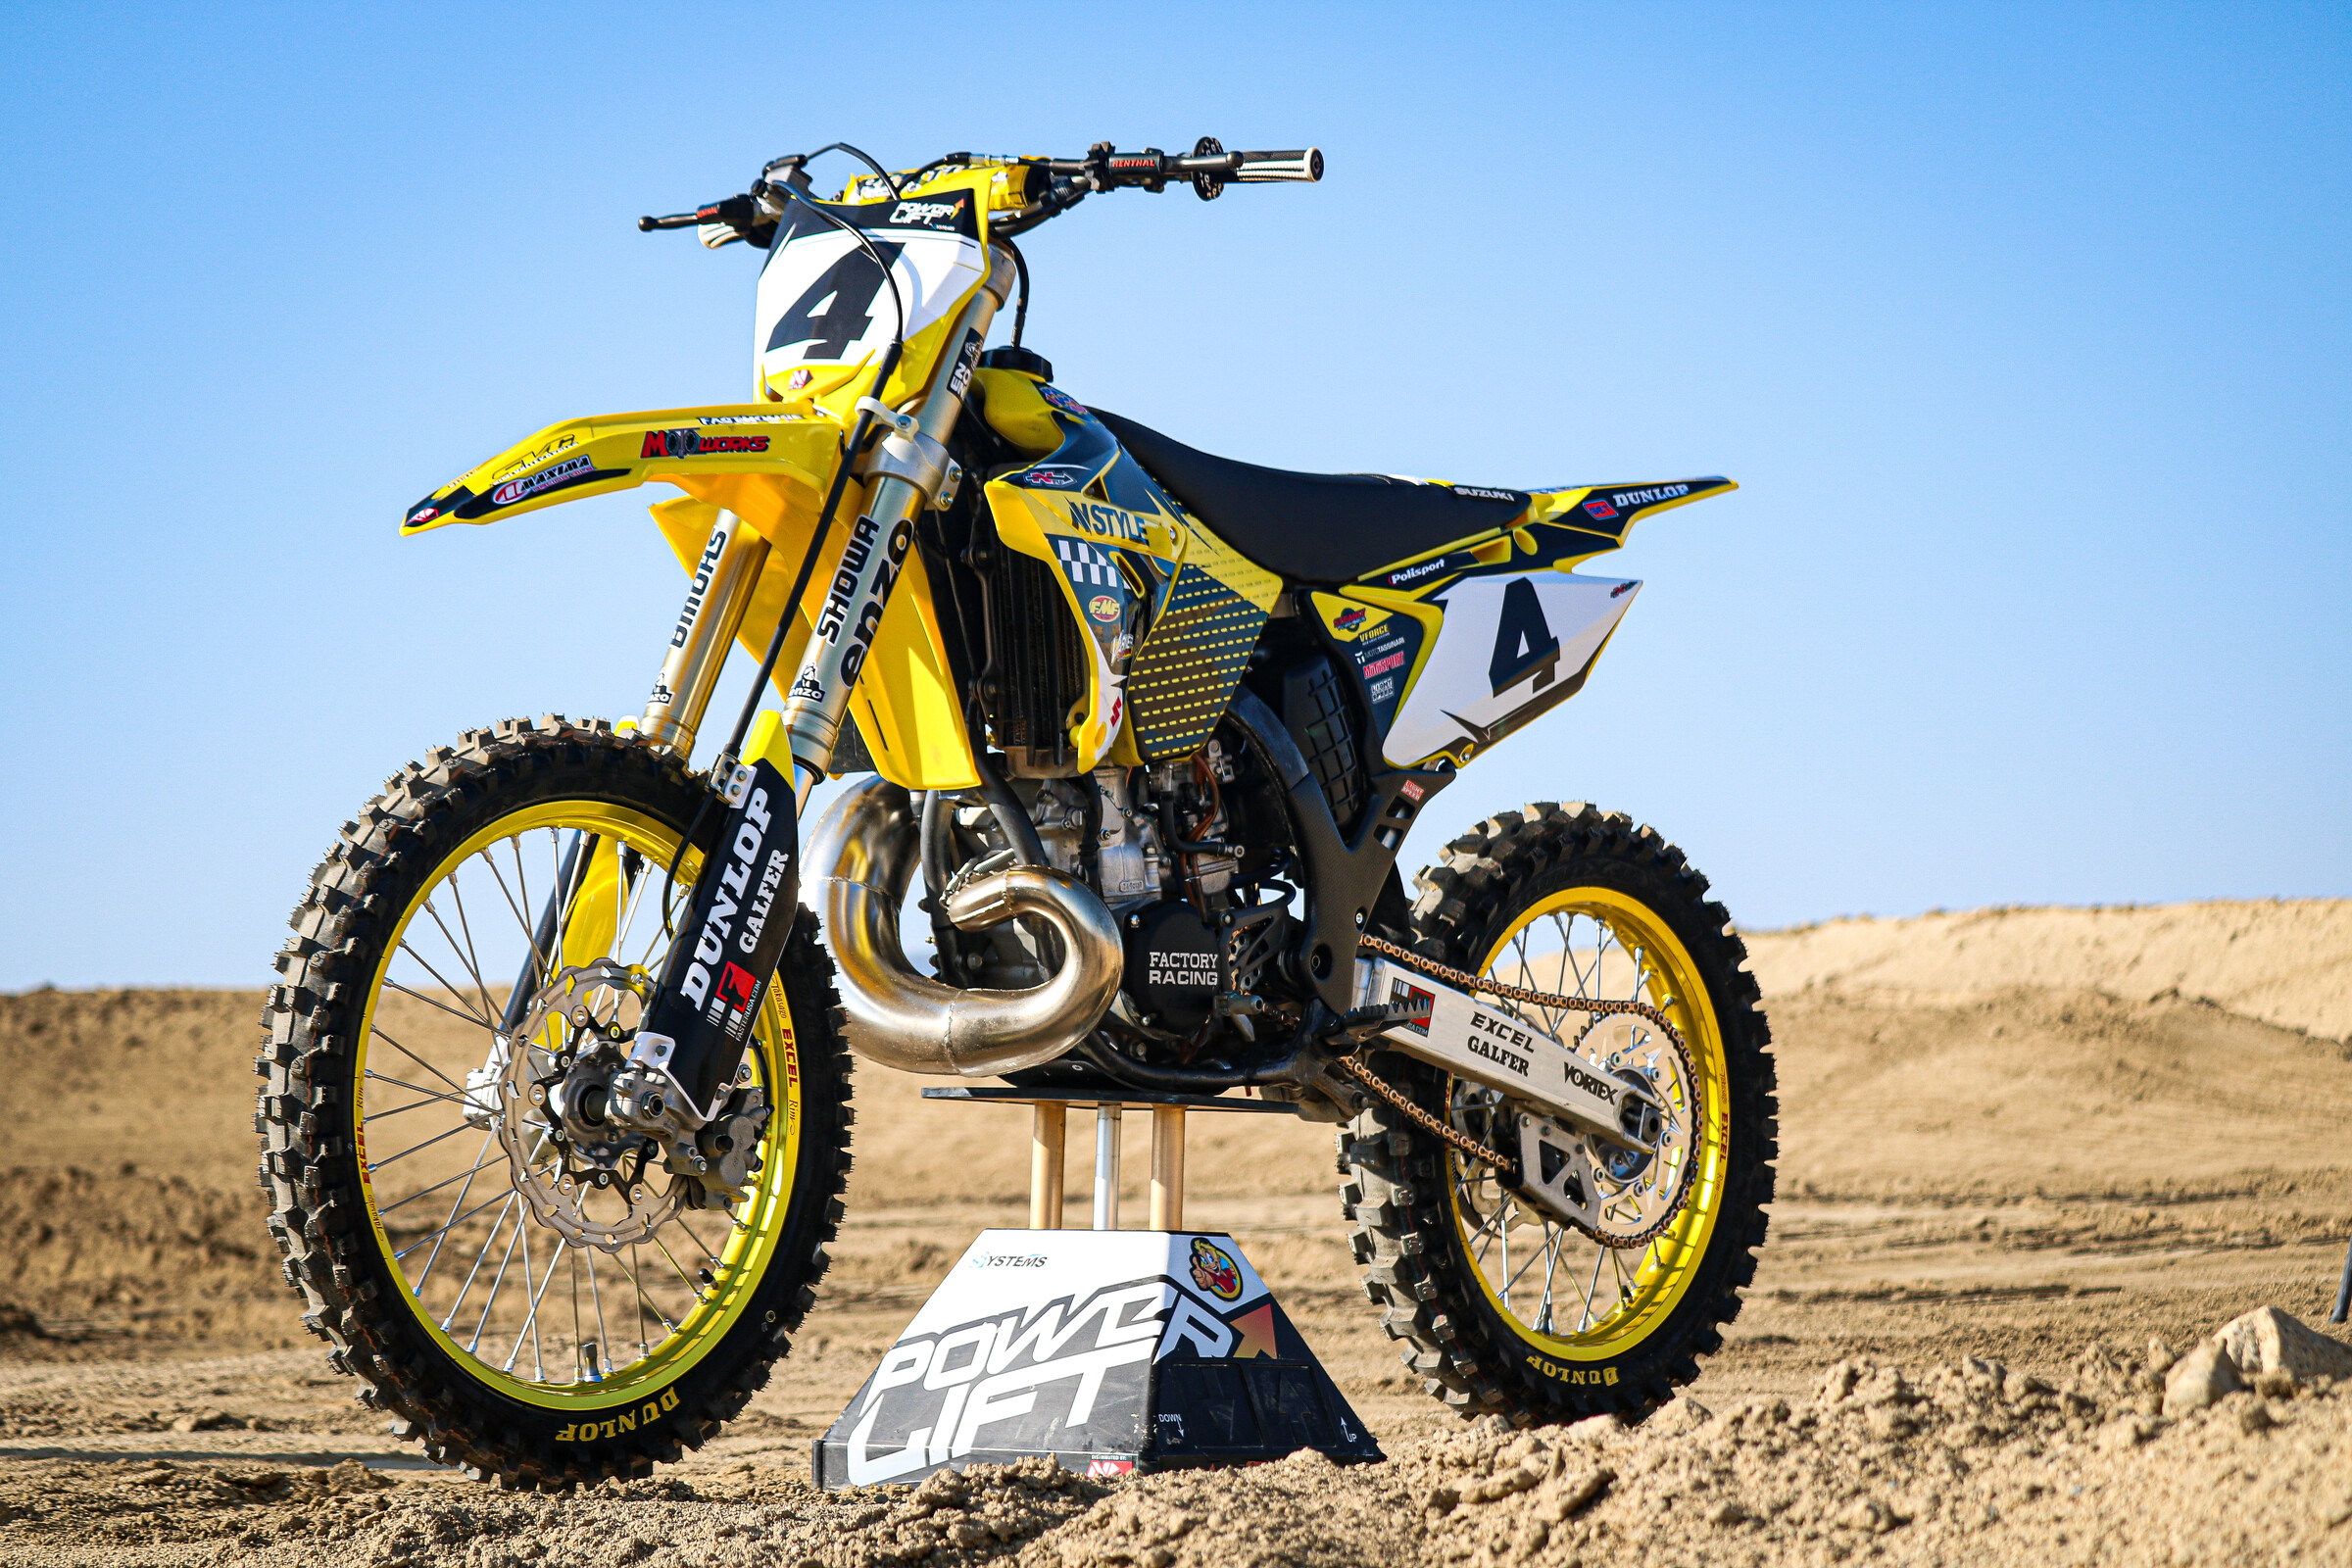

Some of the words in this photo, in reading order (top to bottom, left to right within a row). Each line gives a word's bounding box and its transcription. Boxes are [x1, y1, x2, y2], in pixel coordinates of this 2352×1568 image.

[1111, 159, 1155, 168] RENTHAL
[764, 242, 906, 360] 4
[1453, 486, 1515, 502] SUZUKI
[1612, 484, 1689, 508] DUNLOP
[816, 514, 880, 647] SHOWA
[1391, 558, 1446, 584] Polisport
[1089, 599, 1120, 615] FMF
[1488, 576, 1561, 699] 4
[679, 787, 772, 1011] DUNLOP
[739, 849, 789, 955] GALFER
[1149, 952, 1218, 968] FACTORY
[1149, 970, 1218, 986] RACING
[1470, 1010, 1536, 1054] EXCEL
[781, 1027, 799, 1088] EXCEL
[1467, 1035, 1531, 1078] GALFER
[1563, 1060, 1619, 1106] VORTEX
[356, 1121, 371, 1184] EXCEL
[1719, 1112, 1729, 1164] EXCEL
[858, 1277, 1234, 1417] POWER
[1526, 1354, 1619, 1387] DUNLOP
[555, 1386, 681, 1443] DUNLOP
[847, 1337, 1159, 1488] LIFT
[1158, 1413, 1182, 1422] DOWN
[1348, 1433, 1357, 1443] UP
